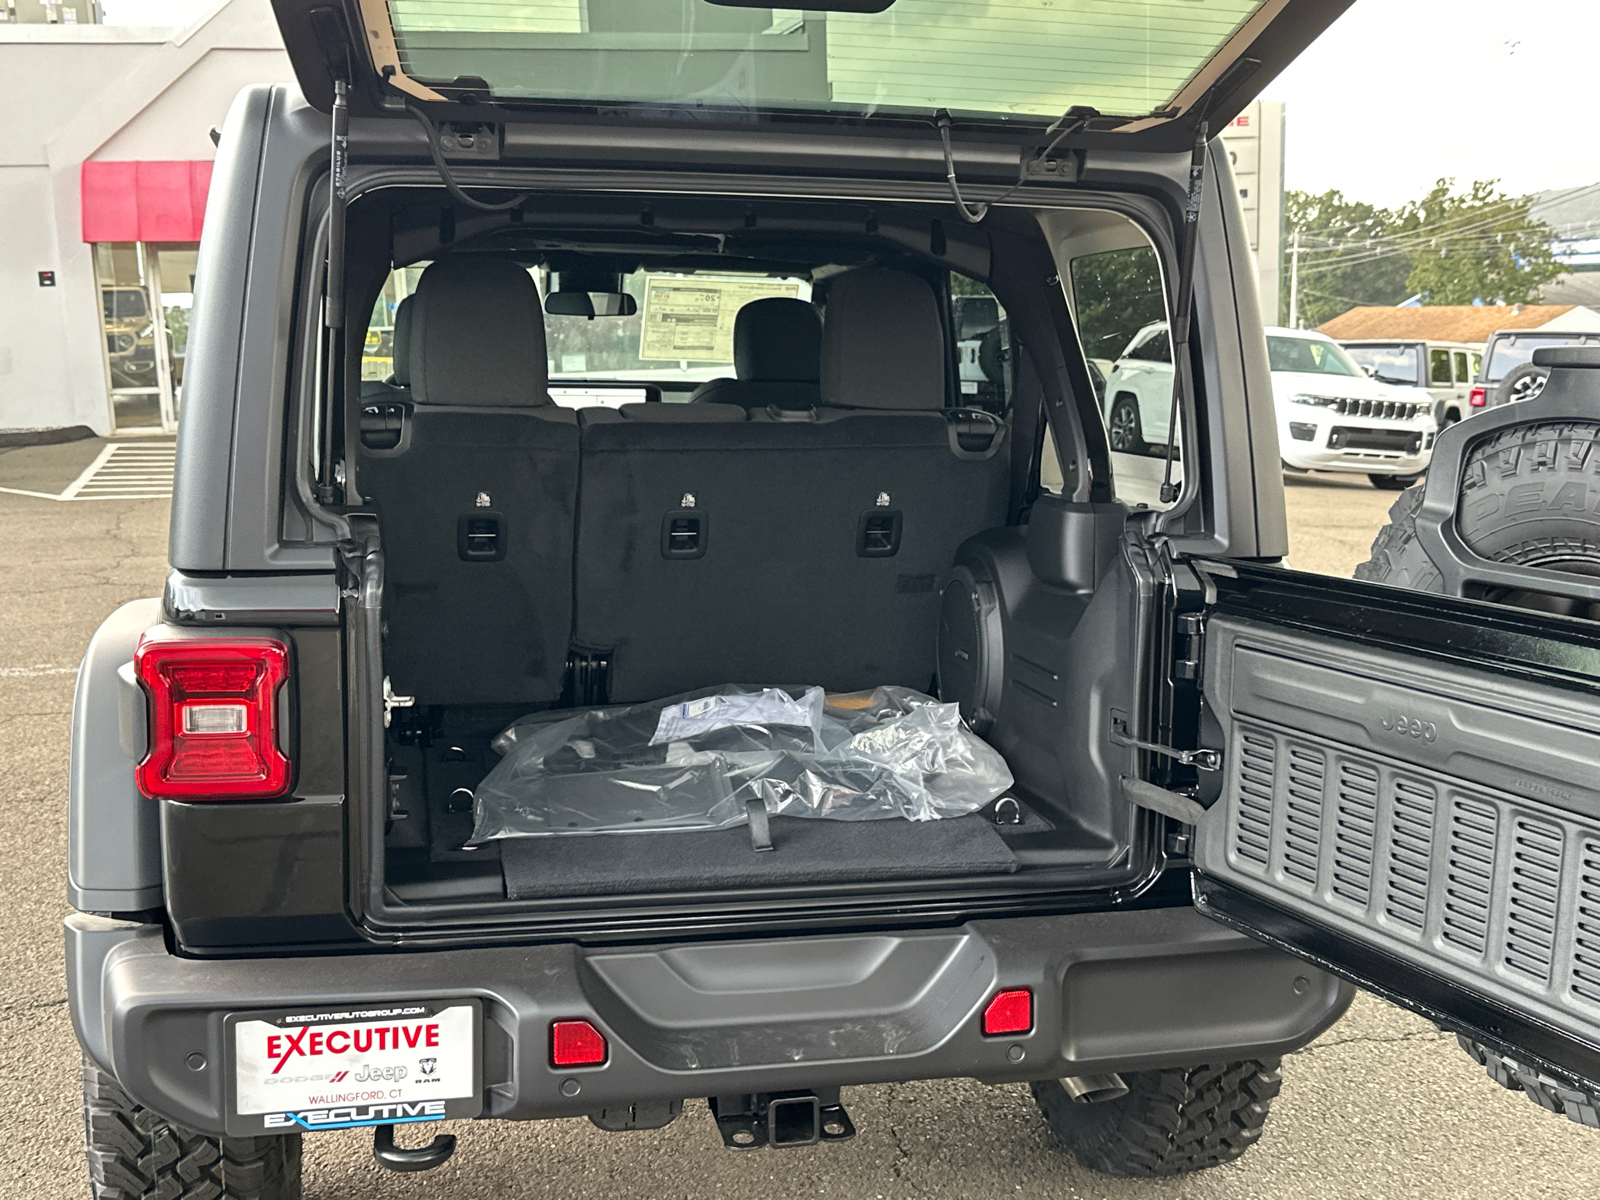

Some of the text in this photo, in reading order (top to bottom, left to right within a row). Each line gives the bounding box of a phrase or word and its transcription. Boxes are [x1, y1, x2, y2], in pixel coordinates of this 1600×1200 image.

[1380, 706, 1437, 745] Jeep
[267, 1024, 439, 1074] EXECUTIVE
[355, 1065, 408, 1082] Jeep
[309, 1089, 402, 1104] WALLINGFORD, CT
[264, 1101, 445, 1130] EXECUTIVE
